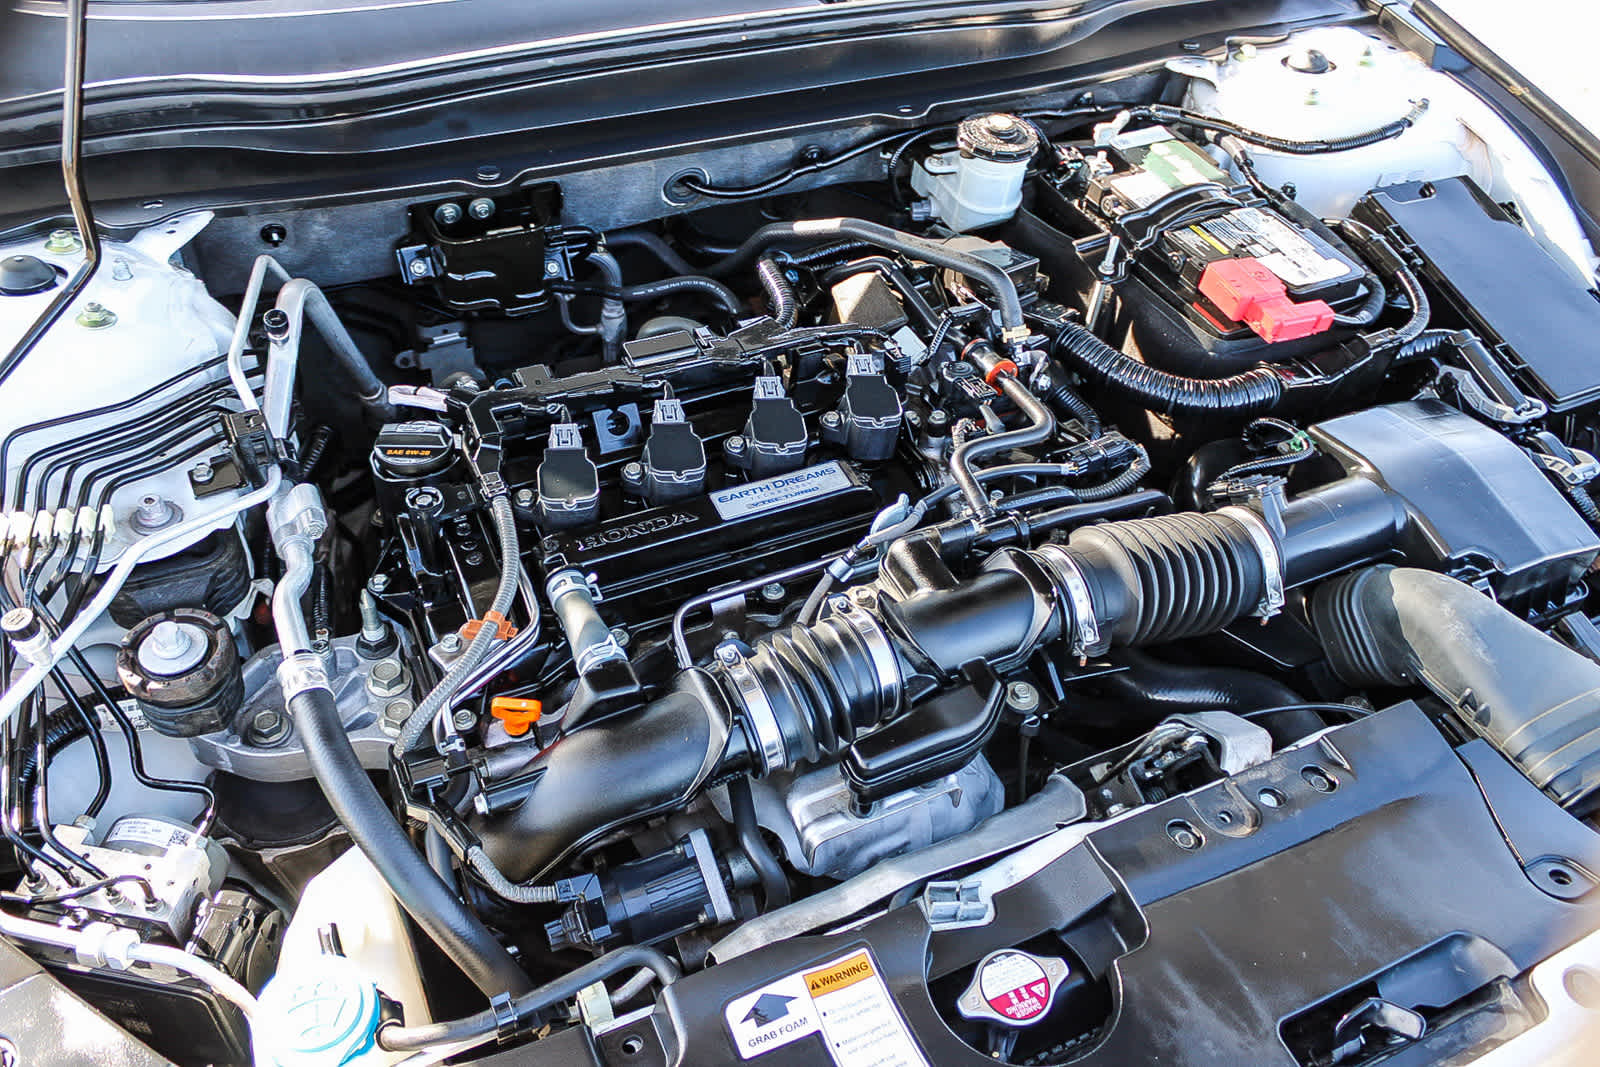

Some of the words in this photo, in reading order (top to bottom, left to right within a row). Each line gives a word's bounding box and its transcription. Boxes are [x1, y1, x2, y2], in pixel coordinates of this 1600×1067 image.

[718, 485, 771, 503] EARTH
[773, 467, 836, 489] DREAMS
[575, 512, 699, 551] HONDA
[818, 961, 869, 987] WARNING
[748, 1030, 778, 1048] GRAB
[779, 1016, 809, 1036] FOAM
